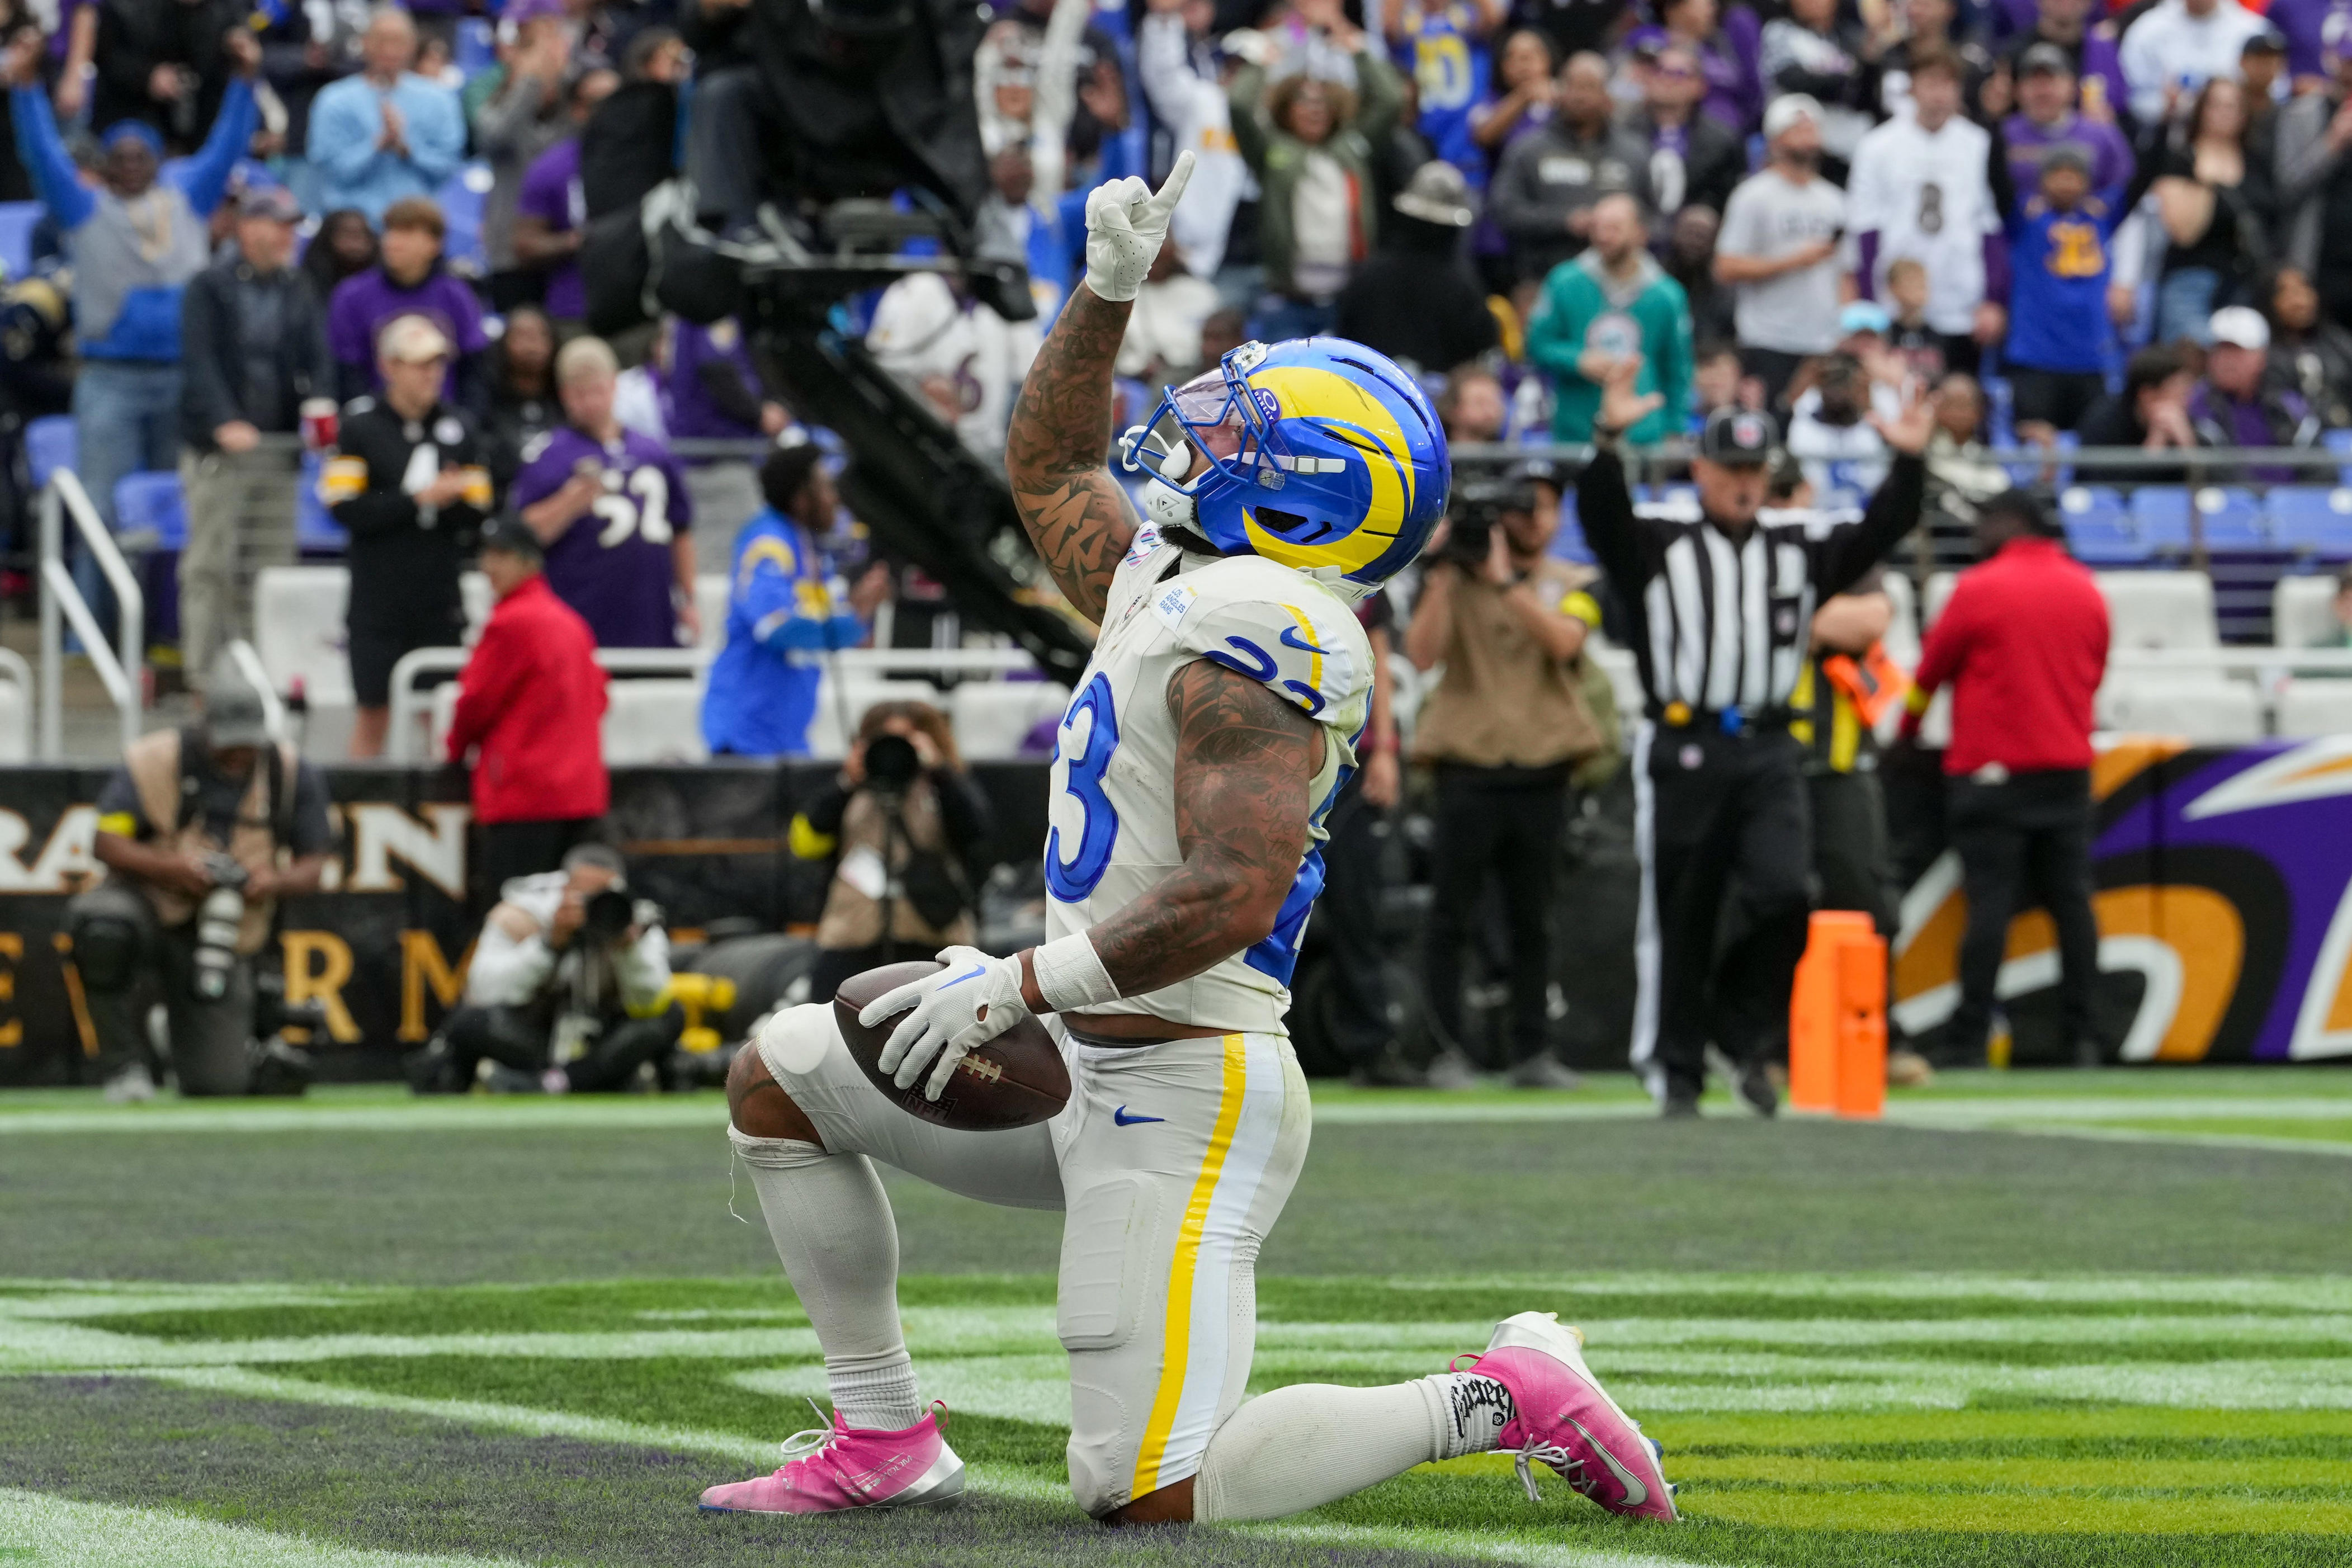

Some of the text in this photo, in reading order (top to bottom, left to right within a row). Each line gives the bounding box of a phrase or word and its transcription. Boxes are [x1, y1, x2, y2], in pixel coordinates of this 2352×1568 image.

[1254, 391, 1274, 421] OAKLEY
[593, 465, 673, 549] 52
[1172, 587, 1183, 598] LOS
[1159, 599, 1174, 615] RAMS
[1165, 594, 1186, 613] ANGELES
